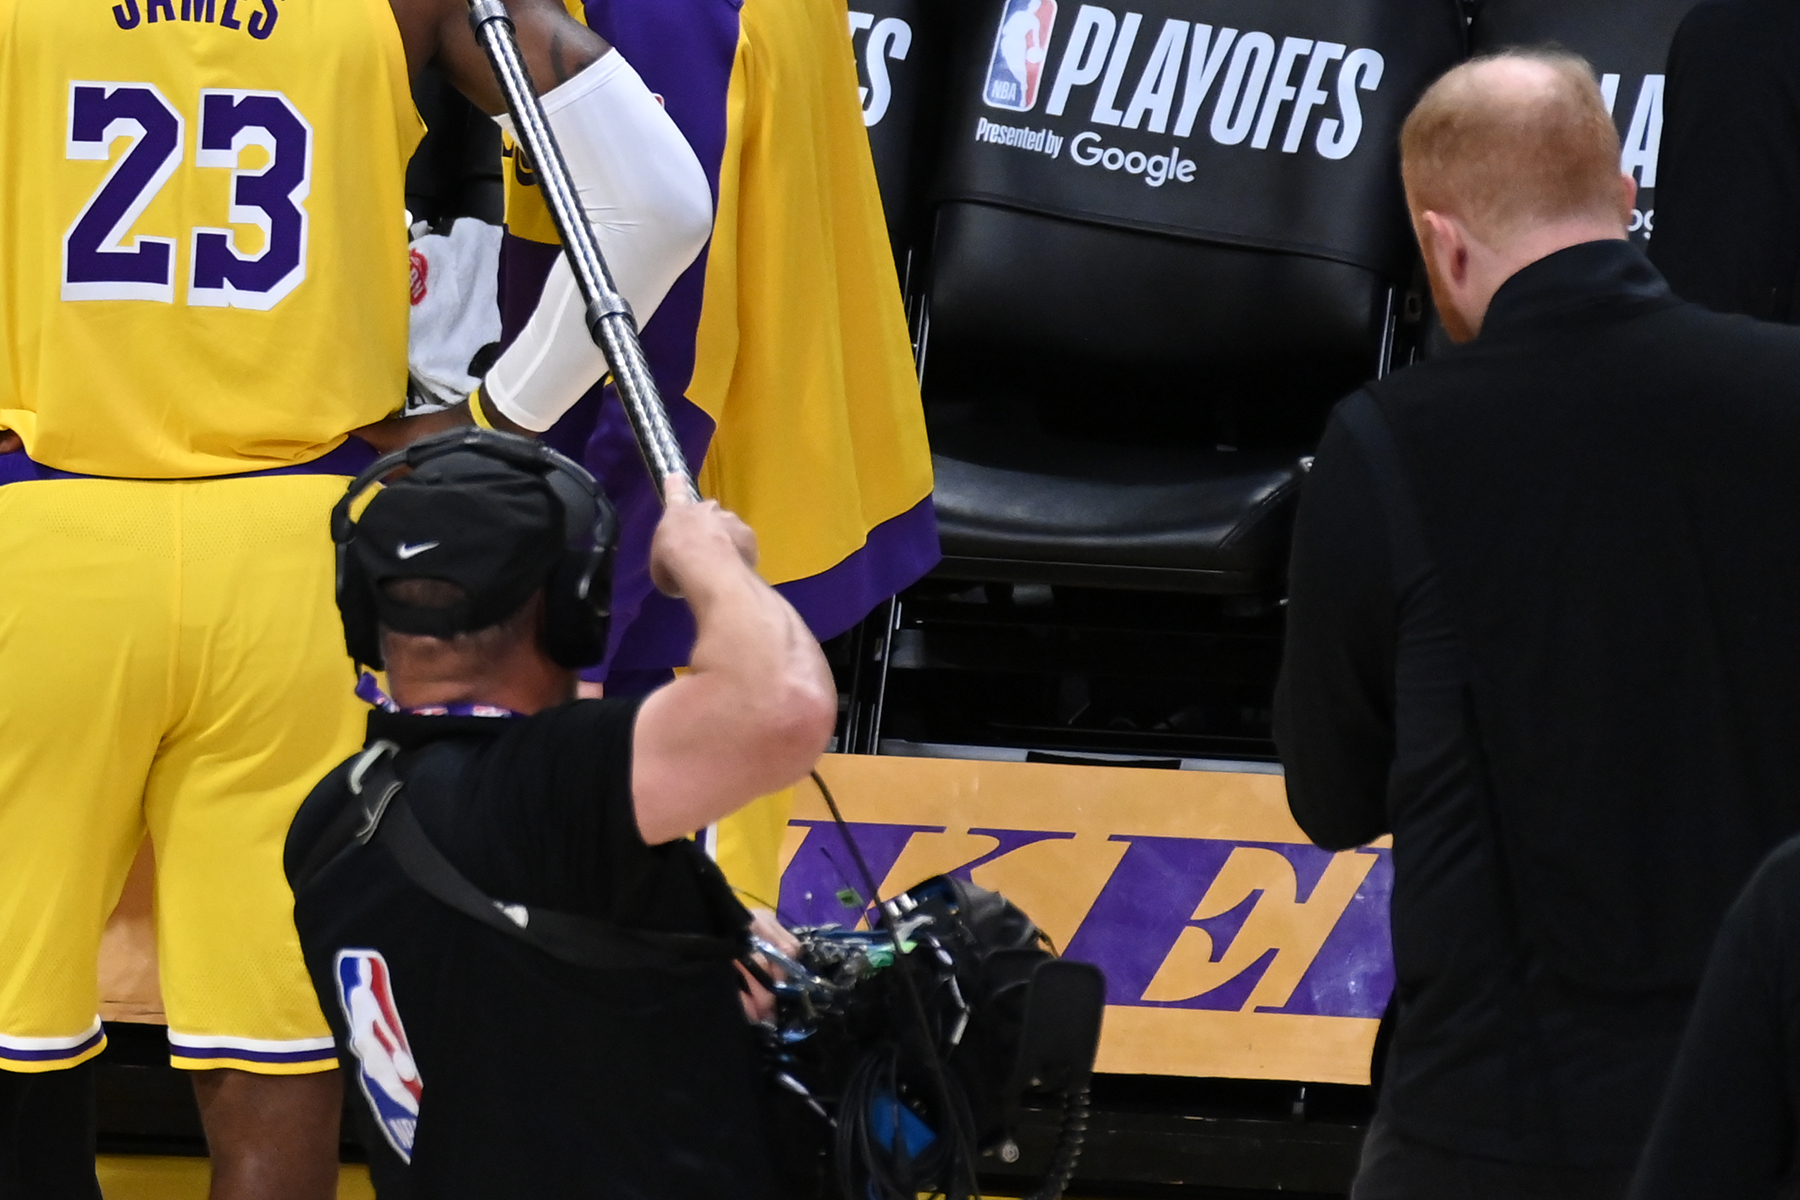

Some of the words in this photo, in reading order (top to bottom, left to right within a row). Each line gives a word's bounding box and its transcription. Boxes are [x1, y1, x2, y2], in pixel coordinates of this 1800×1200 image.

[991, 79, 1017, 101] NBA
[1045, 4, 1385, 160] PLAYOFFS
[60, 79, 313, 311] 23
[975, 117, 1047, 153] Presented
[1044, 129, 1064, 159] by
[1070, 131, 1197, 187] Google
